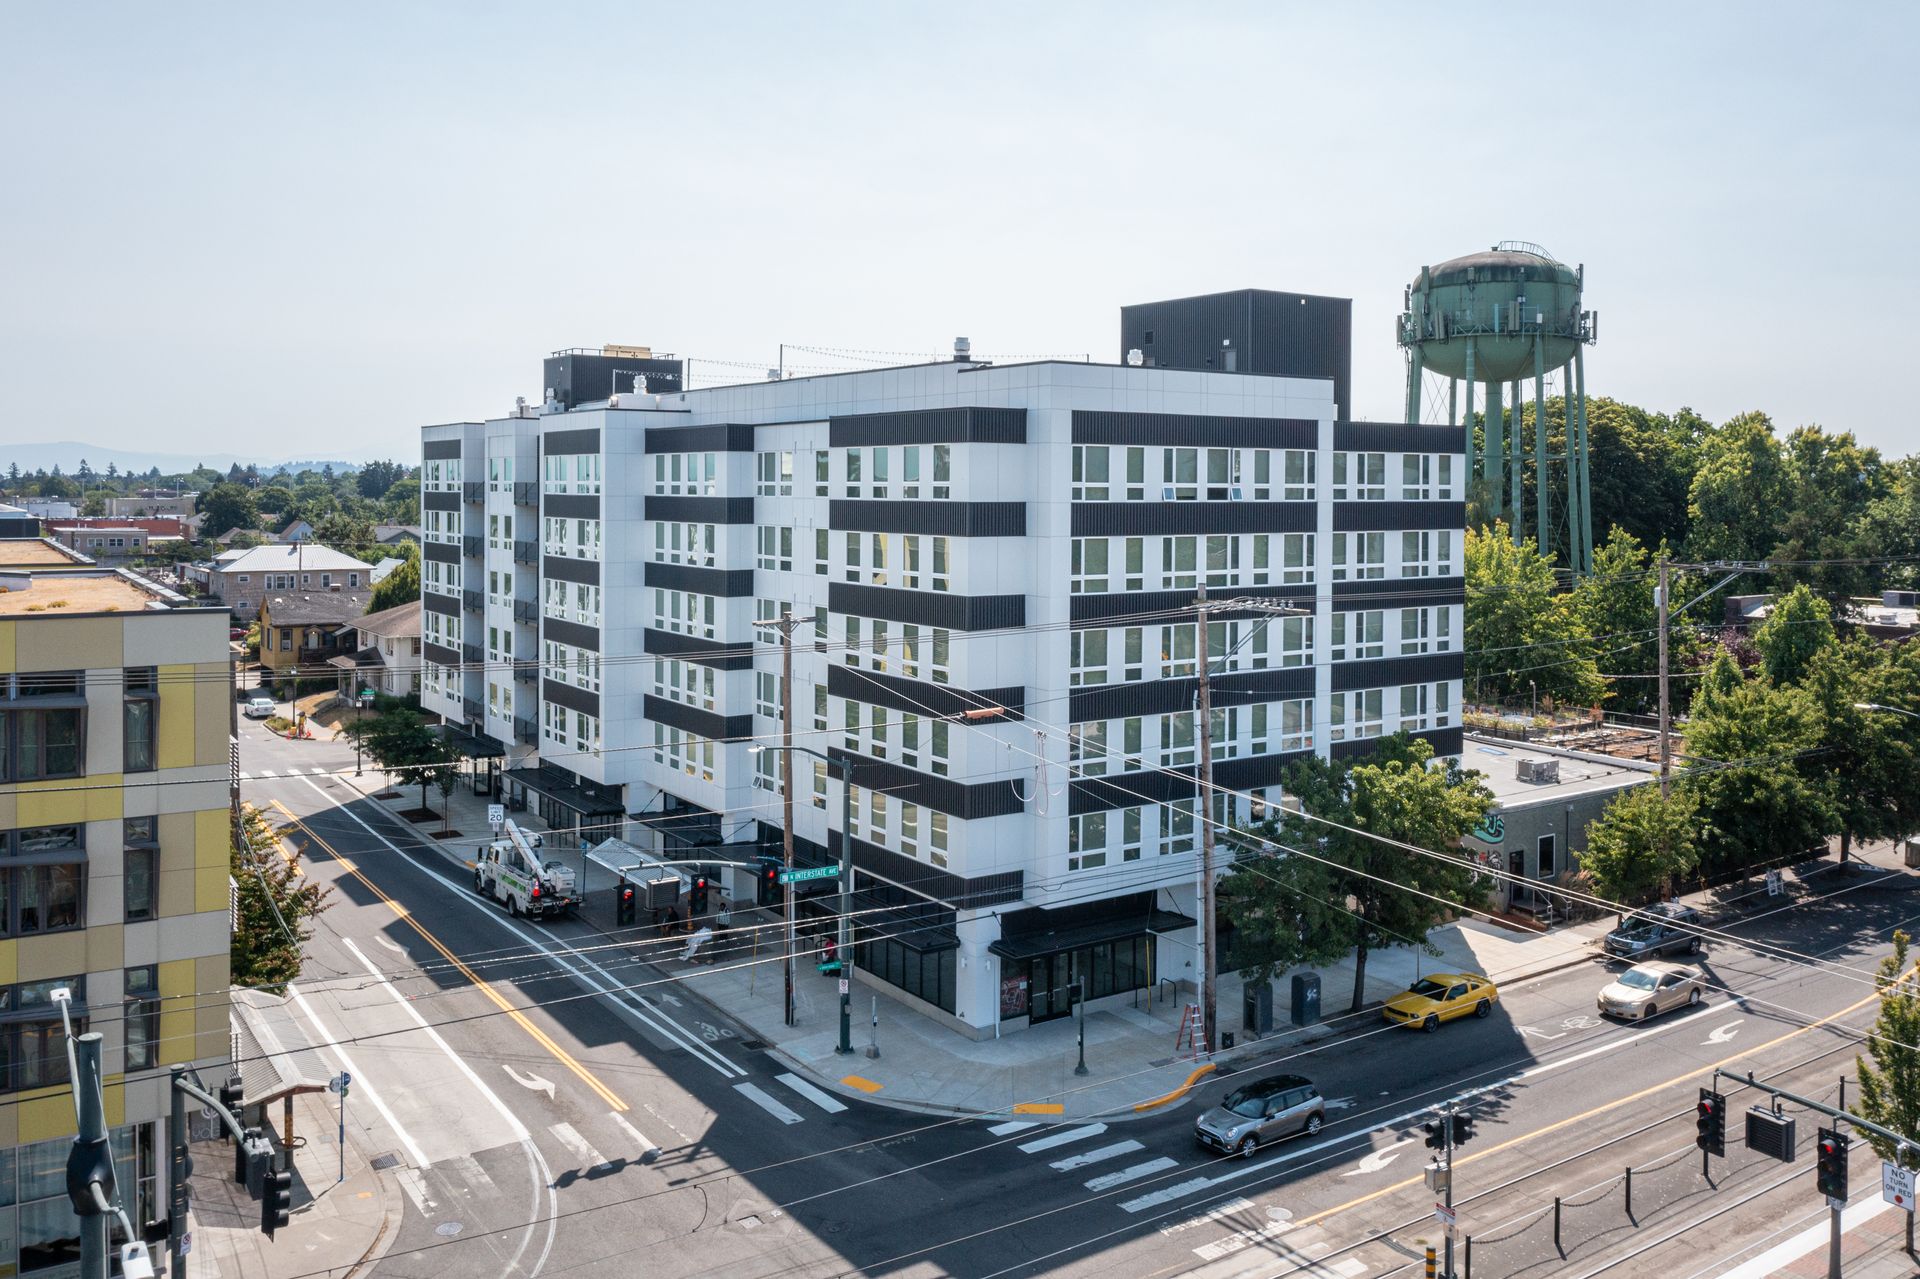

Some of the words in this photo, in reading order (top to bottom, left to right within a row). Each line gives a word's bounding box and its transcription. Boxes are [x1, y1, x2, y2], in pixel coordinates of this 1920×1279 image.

[795, 868, 827, 880] INTERSTATE
[1891, 1169, 1905, 1180] NO
[1889, 1177, 1909, 1189] TURN
[1885, 1183, 1896, 1192] ON
[1898, 1188, 1912, 1198] RED
